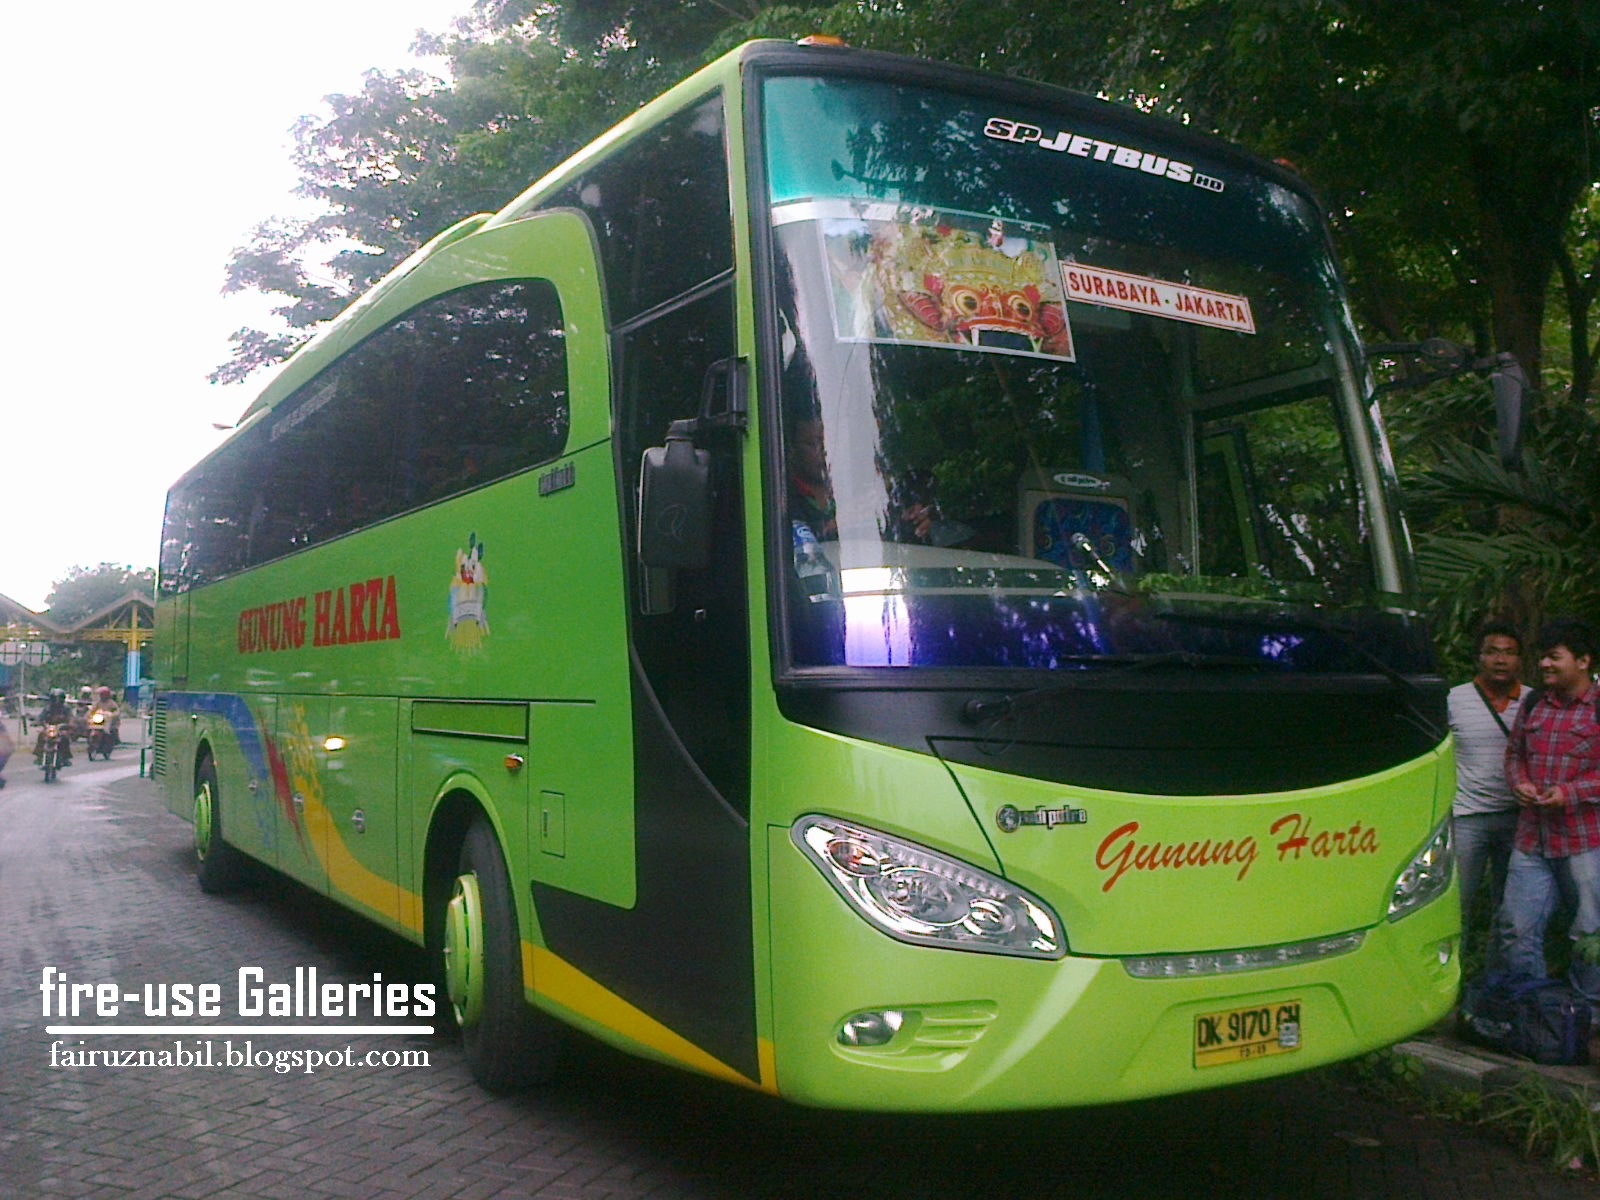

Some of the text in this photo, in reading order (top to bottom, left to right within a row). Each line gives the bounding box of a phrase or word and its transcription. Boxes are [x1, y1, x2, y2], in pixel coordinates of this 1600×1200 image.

[1039, 131, 1193, 182] JETBUS
[1069, 271, 1161, 307] SURABAYA
[1174, 292, 1247, 324] JAKARTA
[238, 575, 401, 654] GUNUNG HARTA
[1096, 813, 1381, 893] Gunung Harta
[1198, 1015, 1223, 1048] DK
[1228, 1008, 1271, 1042] 9170
